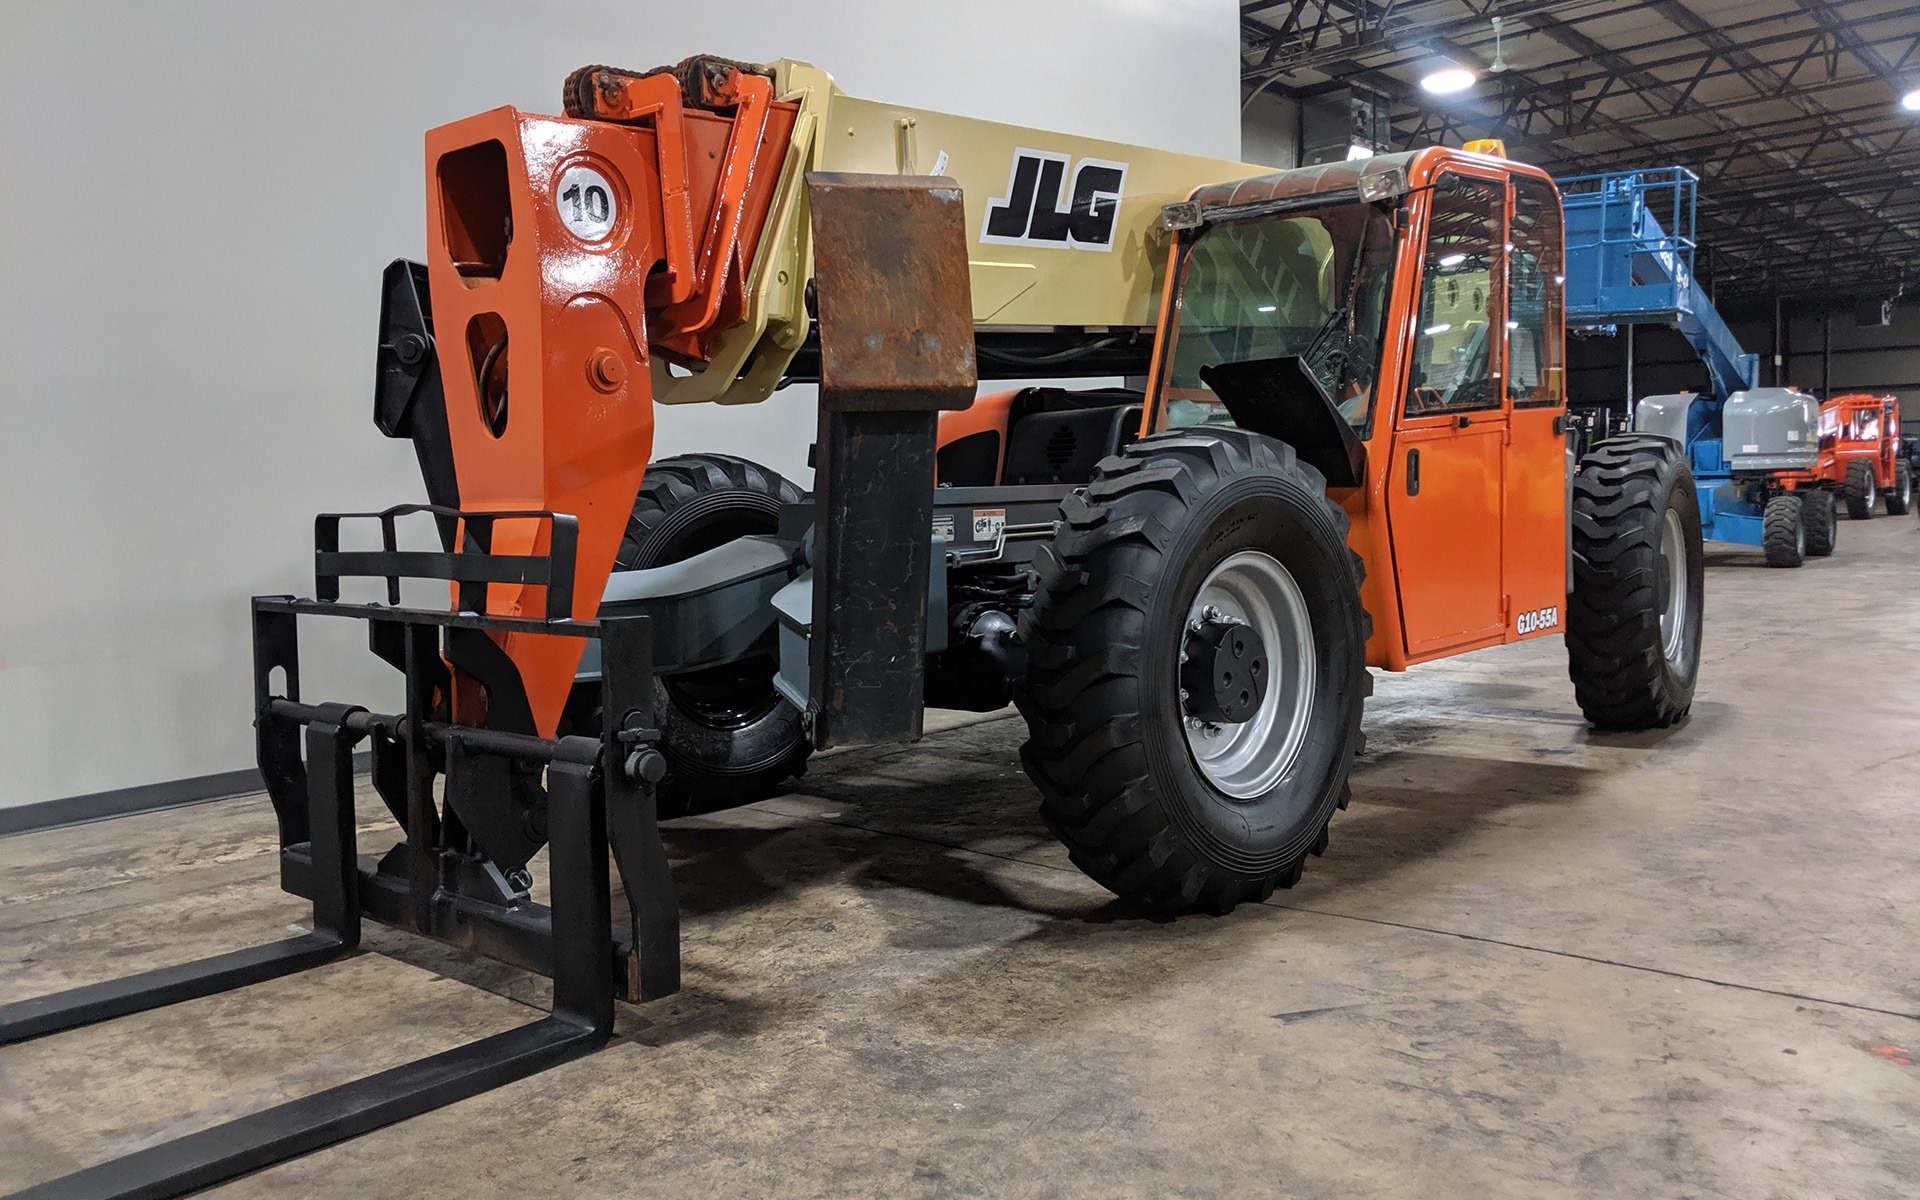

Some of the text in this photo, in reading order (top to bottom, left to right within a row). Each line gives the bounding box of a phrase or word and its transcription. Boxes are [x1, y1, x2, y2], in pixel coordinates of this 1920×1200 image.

[562, 183, 610, 224] 10
[984, 154, 1125, 246] JLG
[1517, 606, 1558, 635] G10-55A
